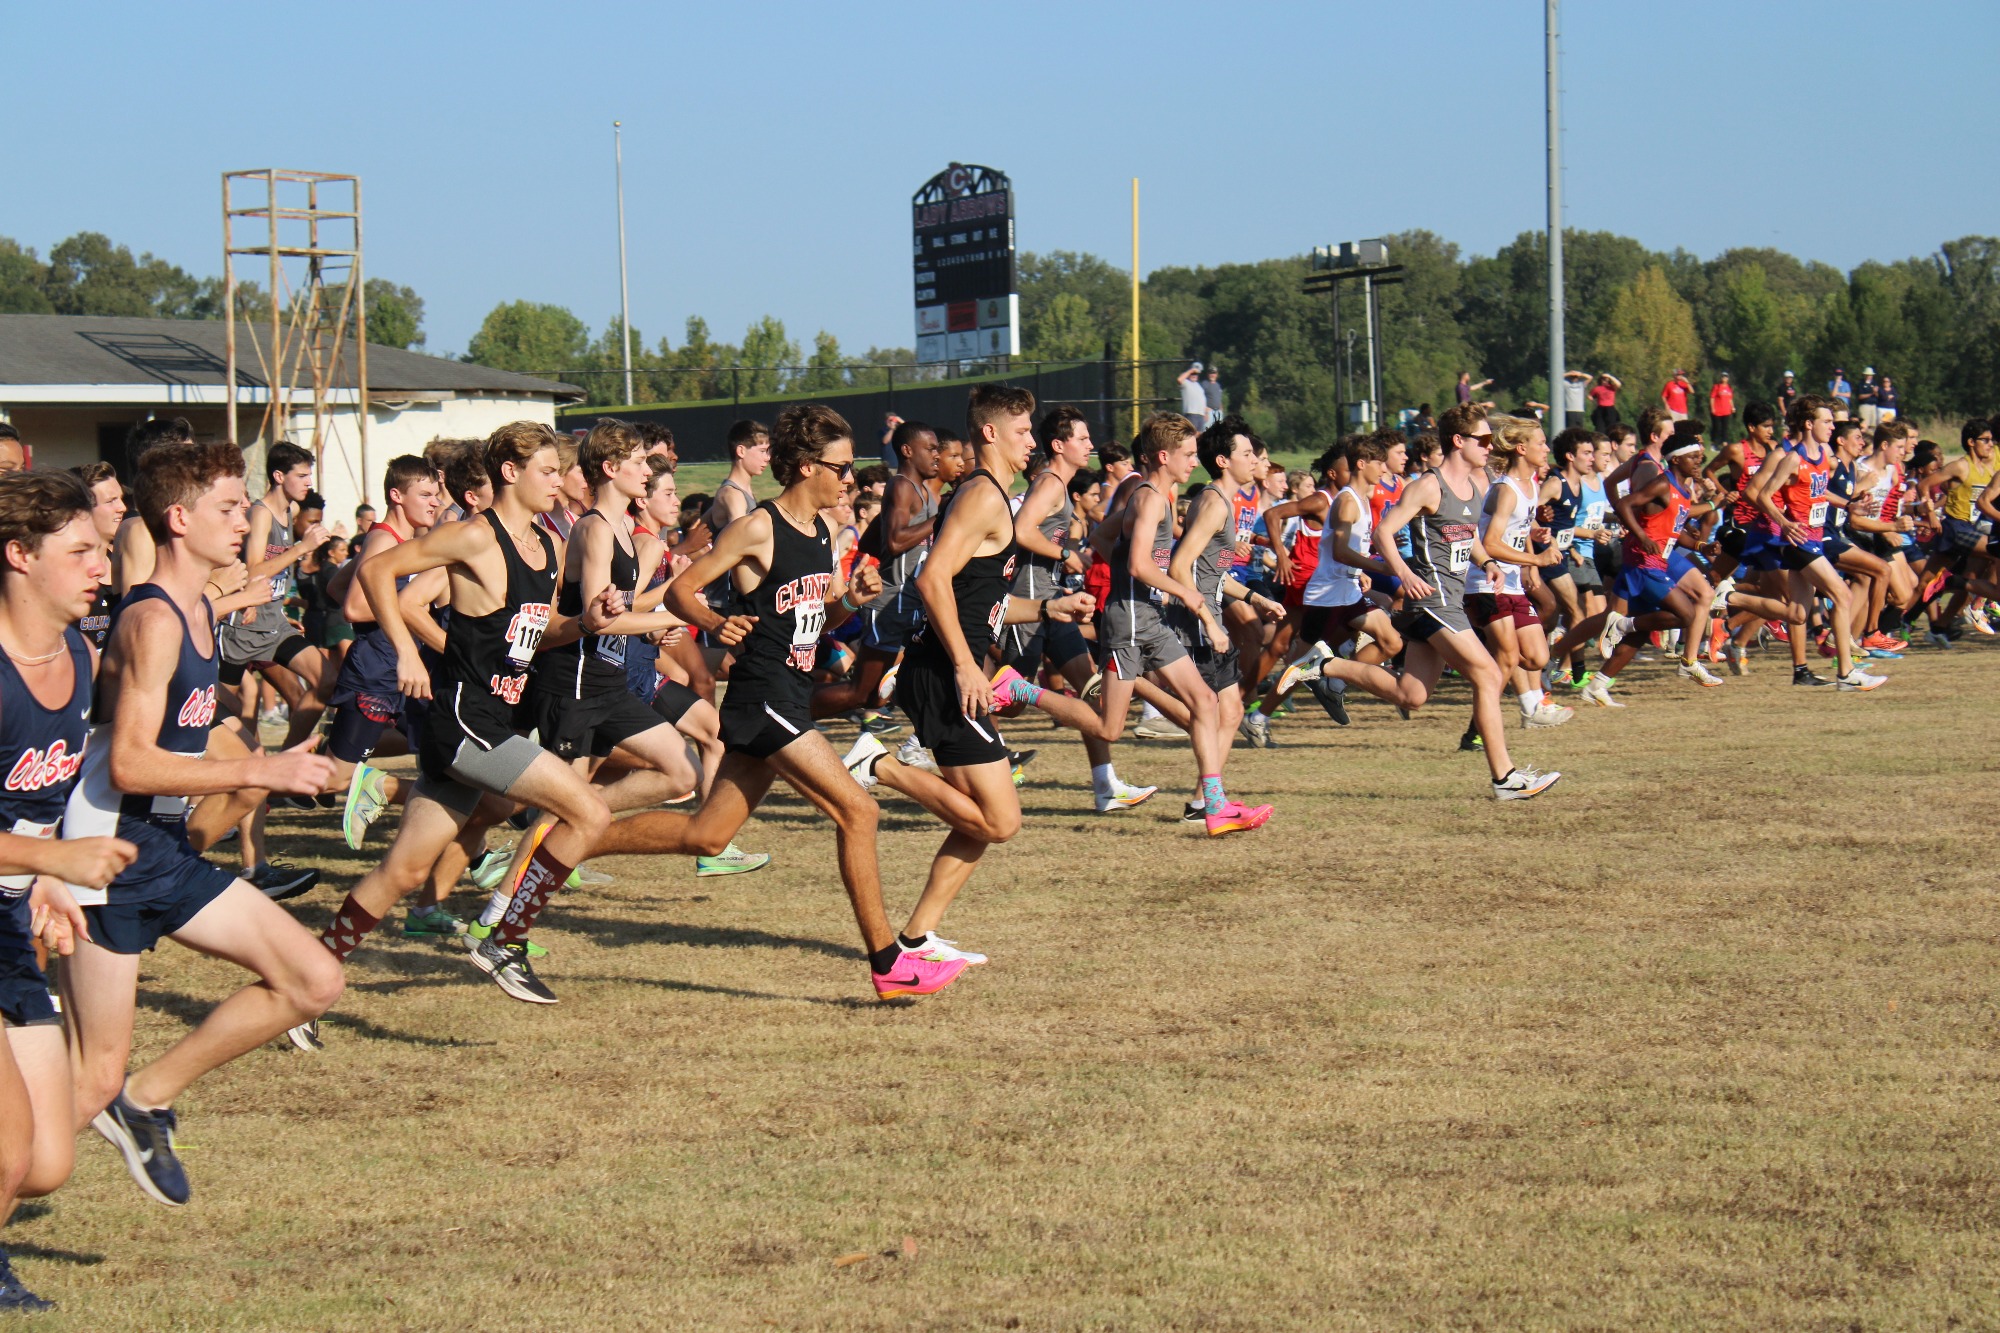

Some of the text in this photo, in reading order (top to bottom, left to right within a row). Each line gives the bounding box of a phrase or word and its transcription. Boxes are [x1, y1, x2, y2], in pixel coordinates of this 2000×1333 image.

[914, 192, 1006, 229] LADY ARROWS
[519, 625, 543, 651] 118
